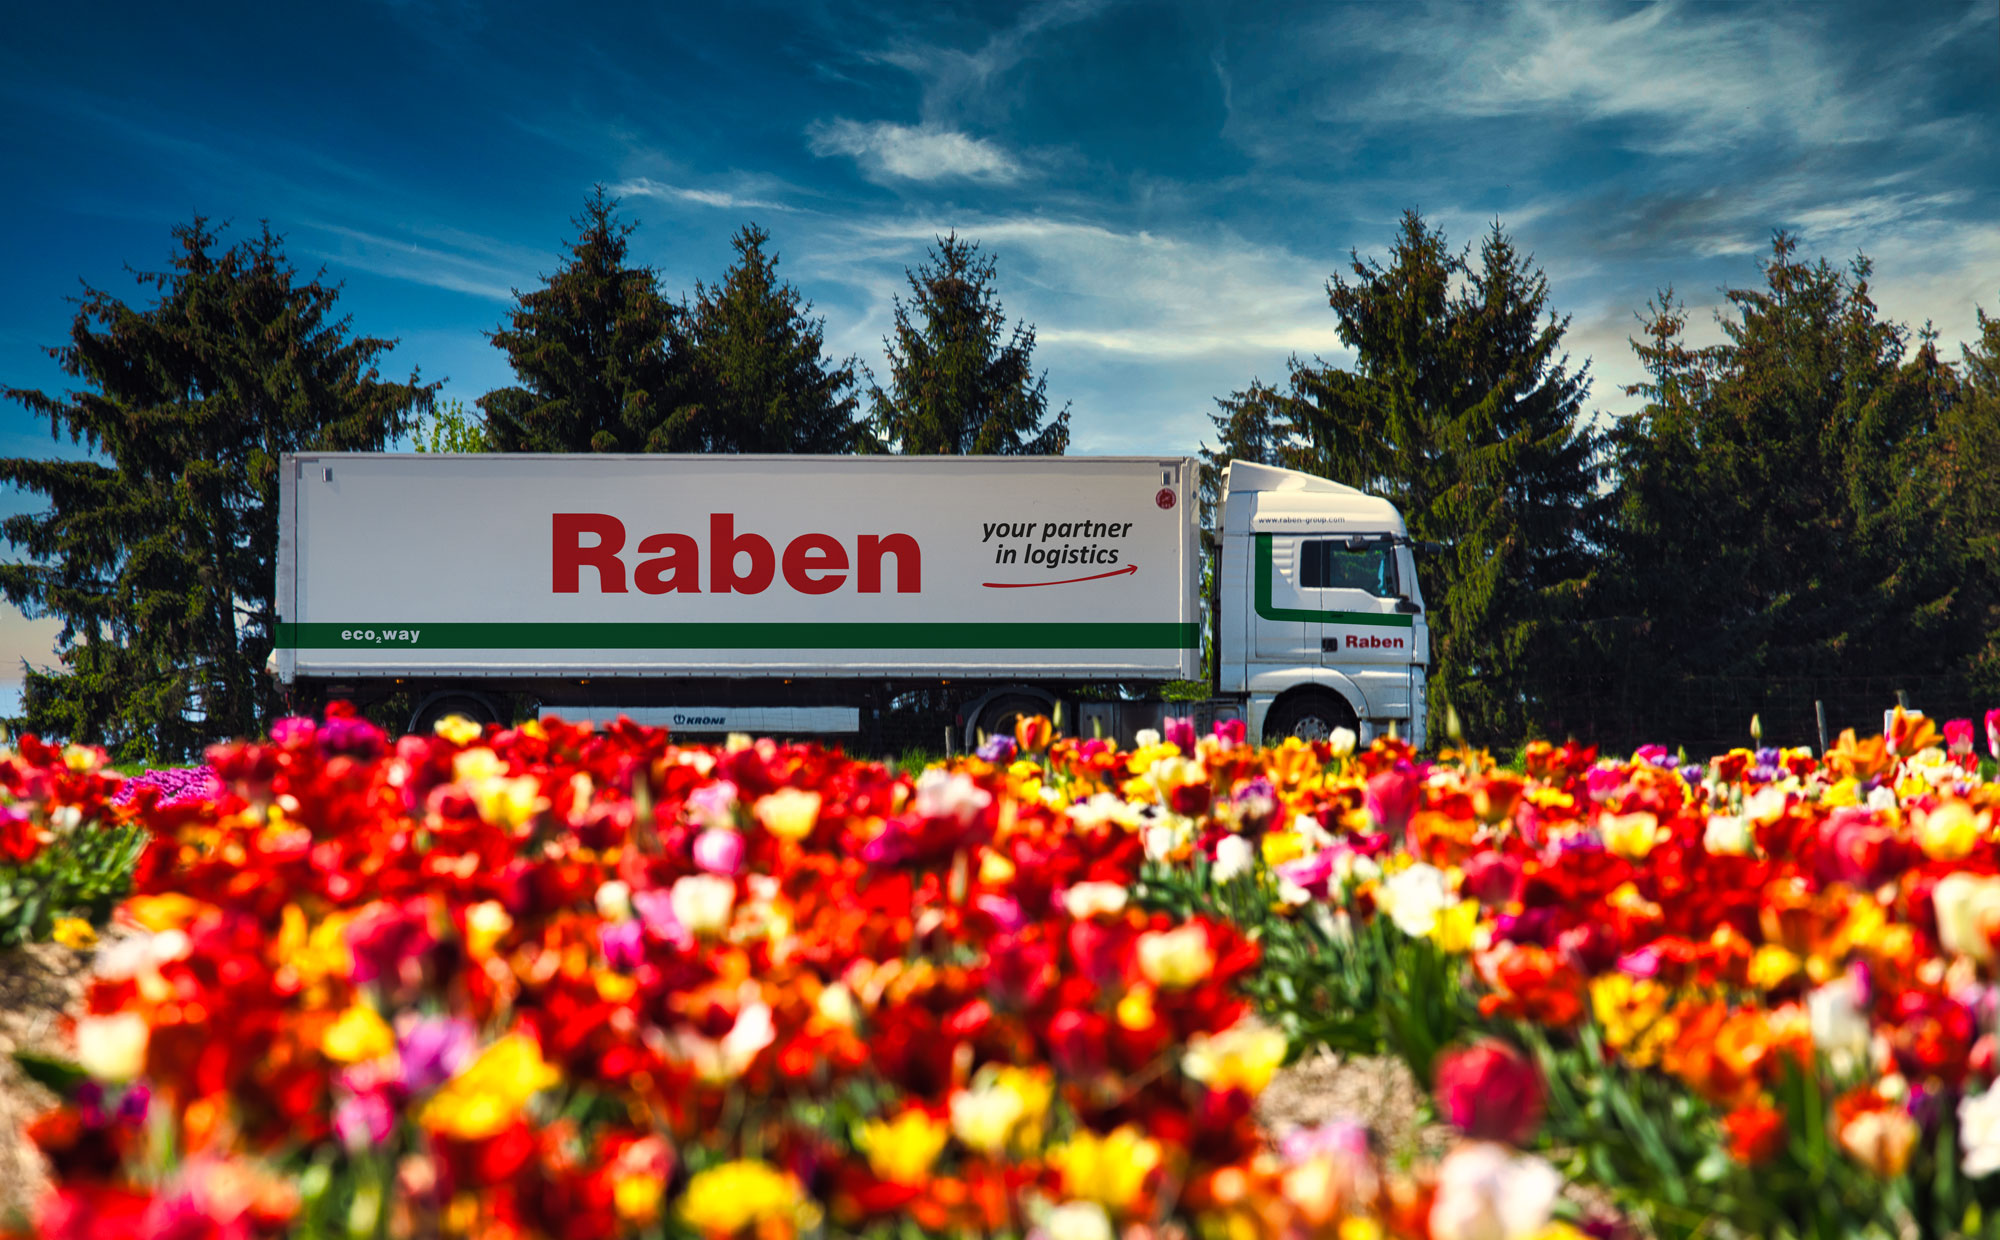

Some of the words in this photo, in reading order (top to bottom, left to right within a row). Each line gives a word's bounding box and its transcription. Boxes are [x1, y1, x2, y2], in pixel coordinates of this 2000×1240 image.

[982, 522, 1036, 542] your
[1042, 519, 1132, 542] partner
[1258, 516, 1345, 525] www.raben-group.com
[552, 513, 921, 595] Raben
[995, 544, 1016, 564] in
[1024, 543, 1119, 568] logistics
[1345, 635, 1404, 649] Raben
